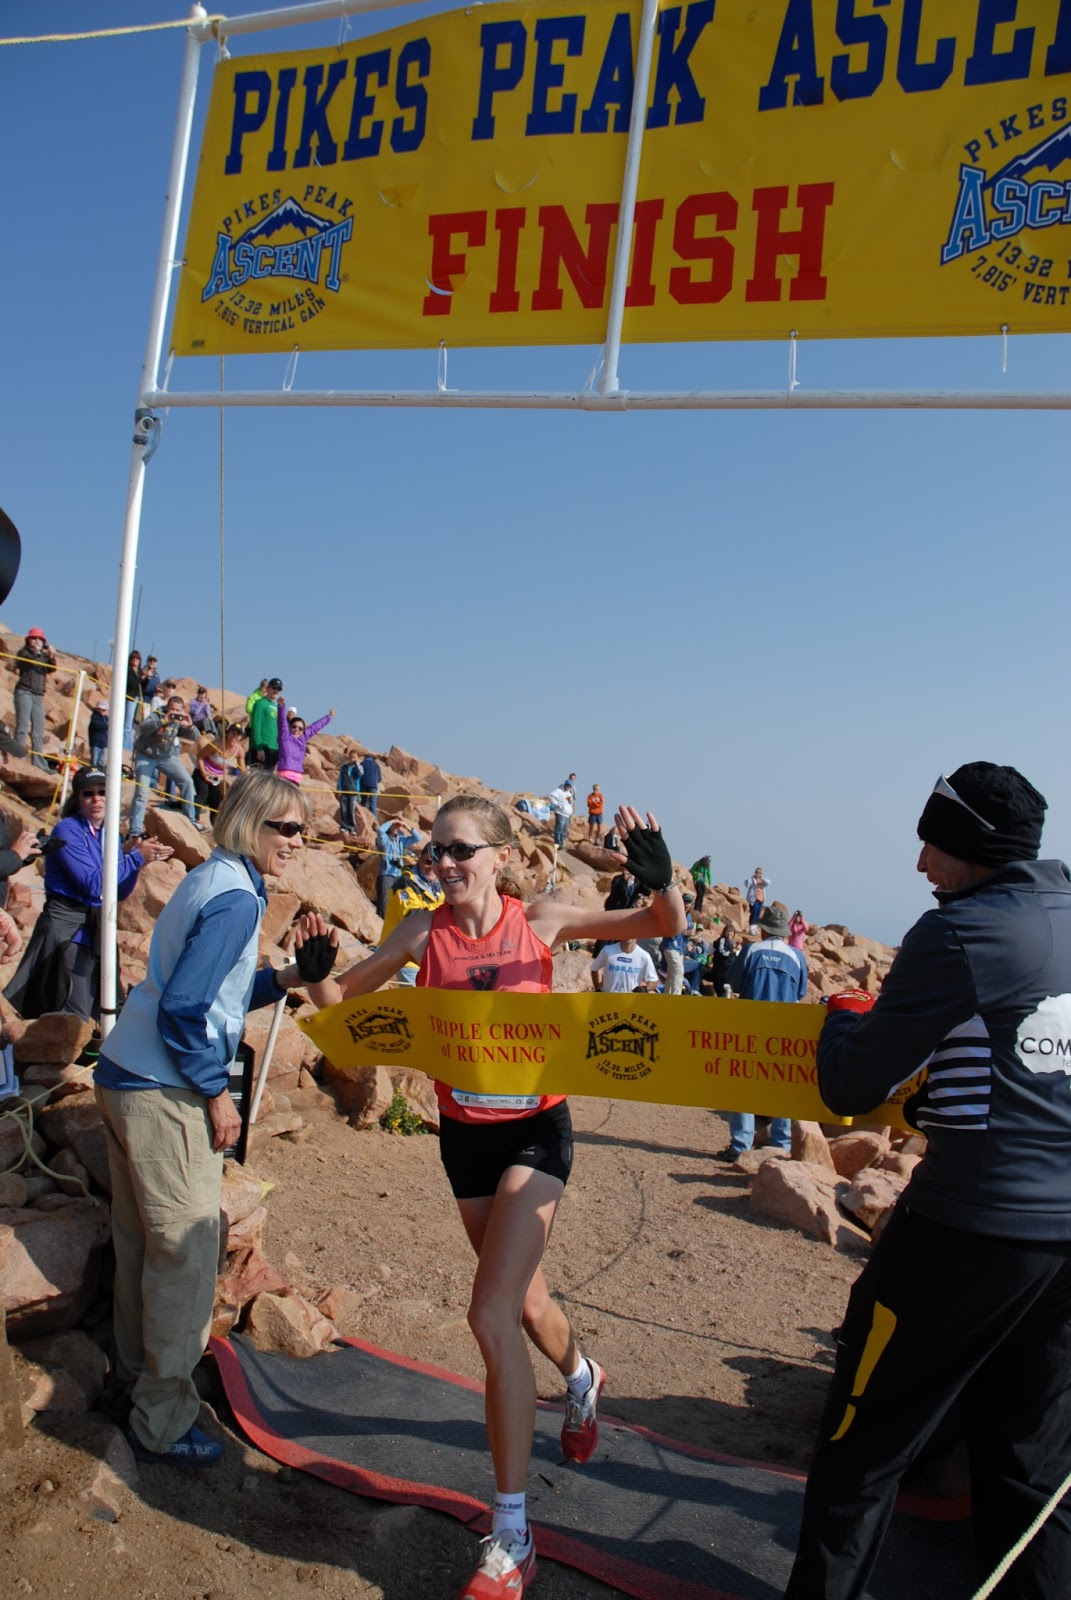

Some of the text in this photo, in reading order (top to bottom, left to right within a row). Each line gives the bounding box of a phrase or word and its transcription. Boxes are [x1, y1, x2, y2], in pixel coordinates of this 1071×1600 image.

[225, 37, 431, 175] PIKES
[471, 0, 716, 141] PEAK
[963, 97, 1068, 163] PIKES
[222, 185, 354, 233] PIKES PEAK
[202, 215, 354, 304] ASCENT
[422, 182, 835, 317] FINISH
[997, 241, 1054, 278] 13.32
[229, 288, 316, 316] 13.32 MILES
[243, 317, 295, 334] VERTICAL
[300, 298, 326, 323] GAIN
[346, 1017, 412, 1044] ASCENT
[428, 1014, 561, 1041] TRIPLE CROWN
[589, 1012, 657, 1031] PIKES PEAK
[441, 1043, 546, 1063] of RUNNING
[585, 1030, 659, 1063] ASCENT
[688, 1030, 757, 1054] TRIPLE
[612, 1071, 638, 1081] VERTICAL
[624, 1061, 646, 1073] MILES
[704, 1057, 721, 1075] of
